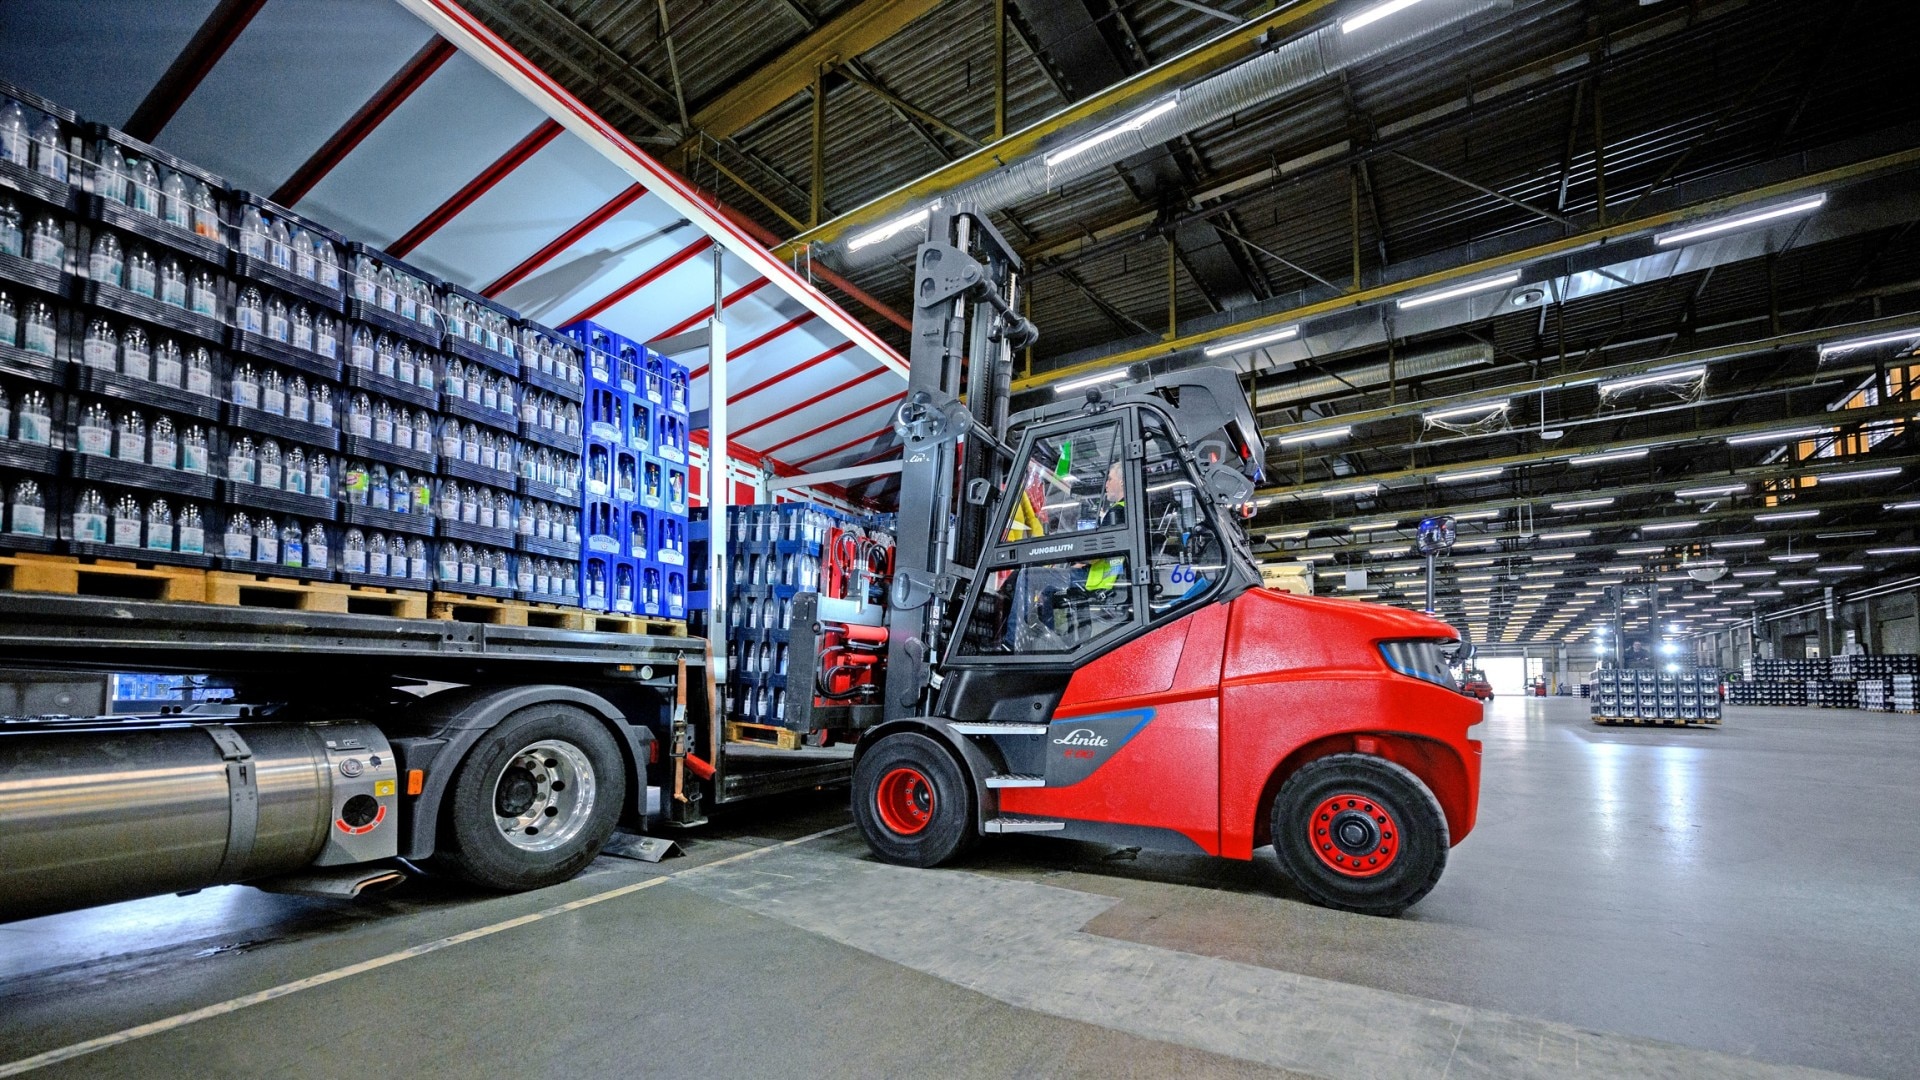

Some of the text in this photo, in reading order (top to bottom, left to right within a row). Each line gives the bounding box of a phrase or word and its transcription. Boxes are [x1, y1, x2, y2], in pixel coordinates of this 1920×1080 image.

[1029, 544, 1073, 556] JUNGBLUTH
[1171, 564, 1195, 584] 66
[1053, 728, 1109, 747] Linde
